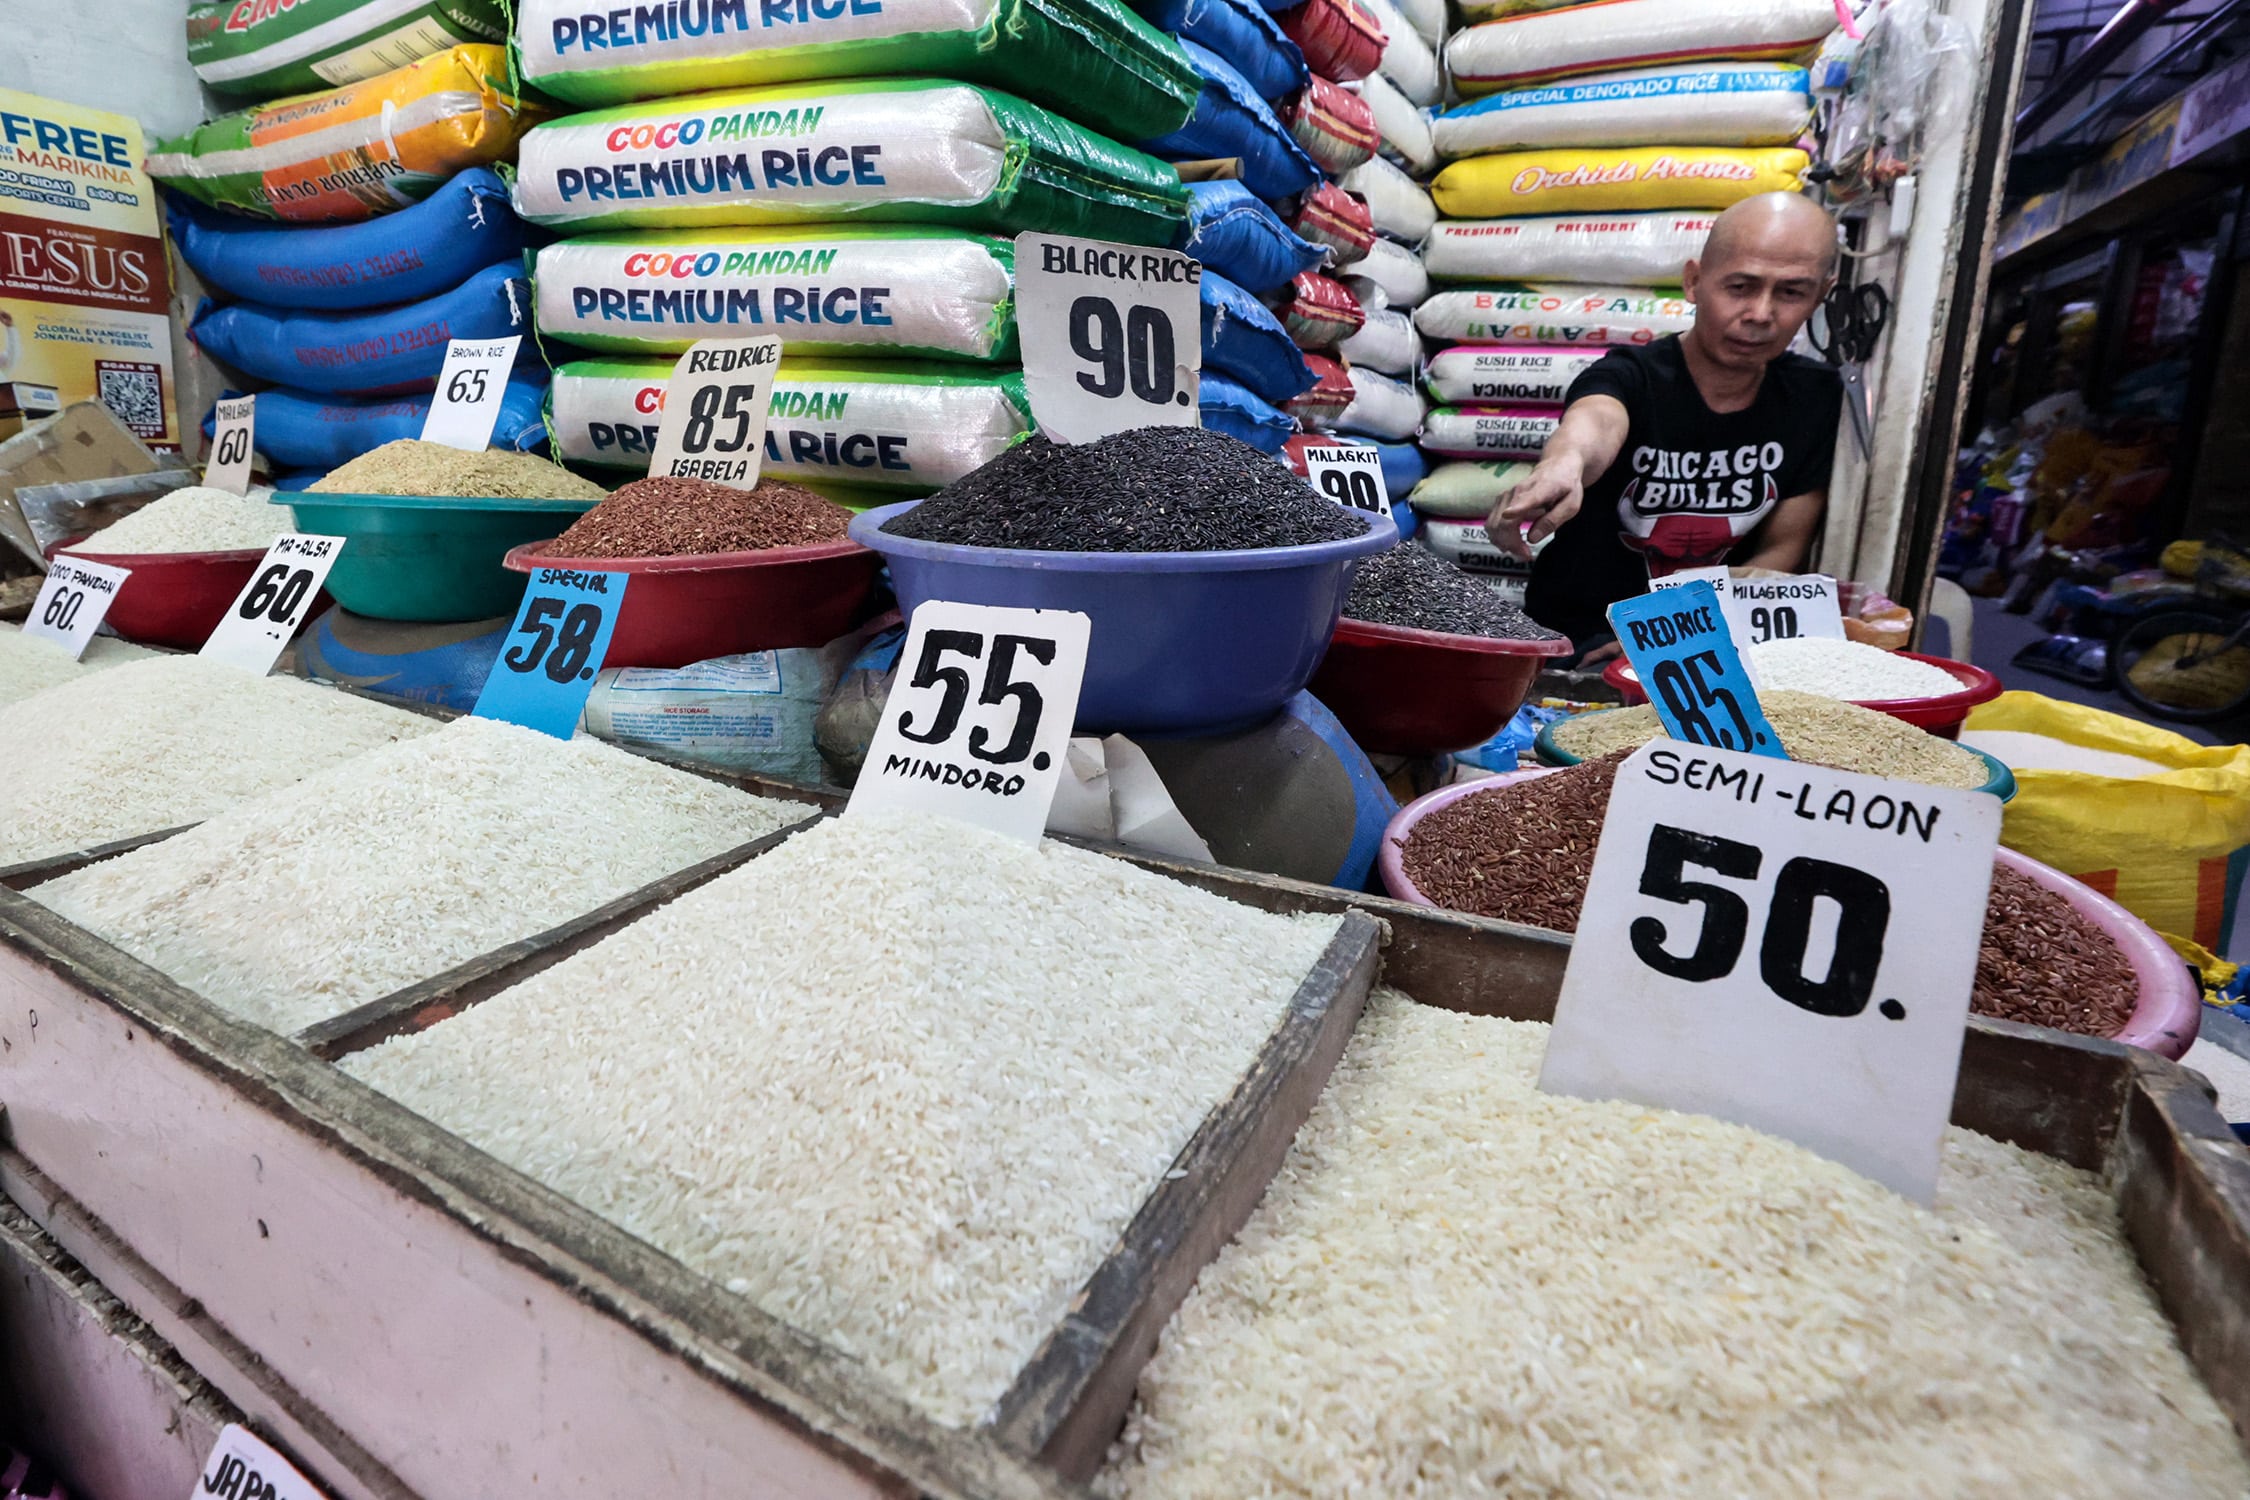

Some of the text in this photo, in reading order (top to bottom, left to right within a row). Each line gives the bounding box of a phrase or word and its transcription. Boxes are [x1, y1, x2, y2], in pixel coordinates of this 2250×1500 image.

[1500, 88, 1568, 107] SPECIAL
[1572, 78, 1673, 100] DENORADO
[1676, 73, 1720, 92] RICE
[1, 111, 132, 168] FREE
[606, 106, 825, 153] COCO PANDAN
[16, 147, 135, 186] MARIKINA
[319, 158, 406, 192] SUPERIOR
[1511, 156, 1756, 195] Orchids Aroma
[1445, 222, 1637, 236] PRESIDENT PRESIDENT
[623, 248, 838, 279] COCO PANDAN
[1041, 243, 1200, 285] BLACK RICE
[33, 331, 94, 343] JONATHAN
[37, 323, 81, 334] GLOBAL
[451, 346, 506, 358] BROWN RICE
[689, 344, 777, 374] RED RICE
[1475, 357, 1553, 367] SUSHI RICE
[1472, 383, 1563, 399] JAPONICA
[768, 391, 849, 421] NDAN
[1476, 419, 1553, 431] SUSHI RICE
[218, 428, 248, 465] 60
[1476, 432, 1549, 449] PONICA
[670, 458, 748, 481] ISABELA
[1307, 449, 1378, 464] MALAGKIT
[1632, 441, 1784, 479] CHICAGO
[1638, 478, 1753, 509] BULLS
[1461, 528, 1489, 540] SUS
[1459, 552, 1530, 569] PONICA
[71, 570, 116, 594] PANDAN
[539, 569, 607, 594] SPECIAL
[1733, 584, 1827, 599] MILAGROSA
[1627, 606, 1716, 651] RED RICE
[883, 754, 1025, 796] MINDORO
